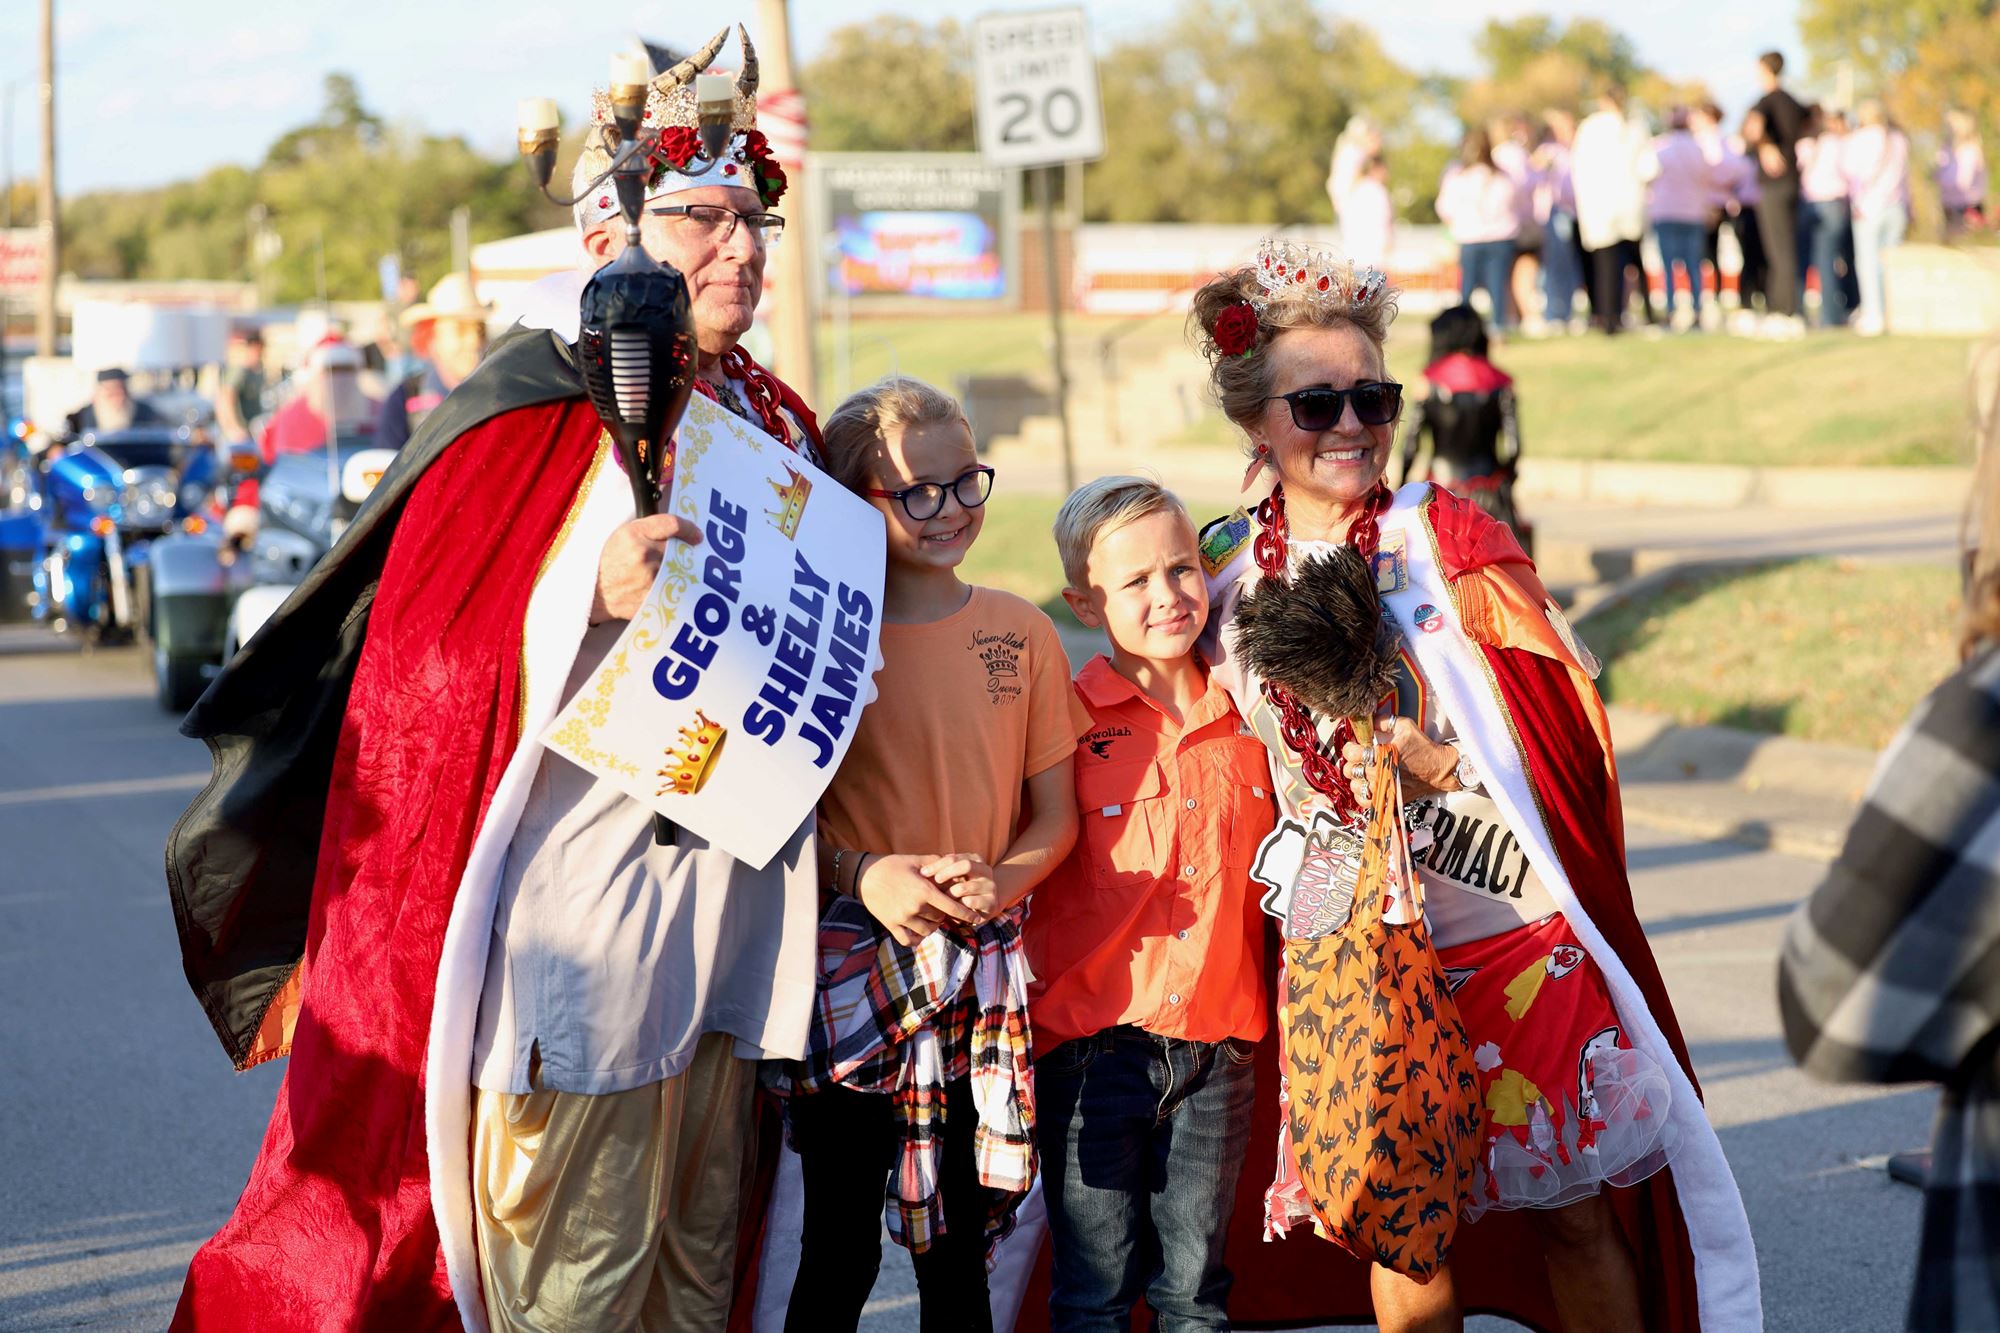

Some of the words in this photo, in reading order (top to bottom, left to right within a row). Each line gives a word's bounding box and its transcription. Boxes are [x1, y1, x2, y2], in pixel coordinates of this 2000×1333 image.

[986, 22, 1077, 53] SPEED
[994, 53, 1070, 85] LIMIT
[995, 86, 1083, 144] 20
[653, 488, 748, 700] GEORGE
[741, 604, 778, 646] &
[743, 548, 830, 747] SHELLY
[798, 581, 873, 769] JAMES
[1077, 726, 1132, 745] eewollah
[1291, 842, 1346, 938] KINGDOM
[1553, 948, 1578, 968] KC
